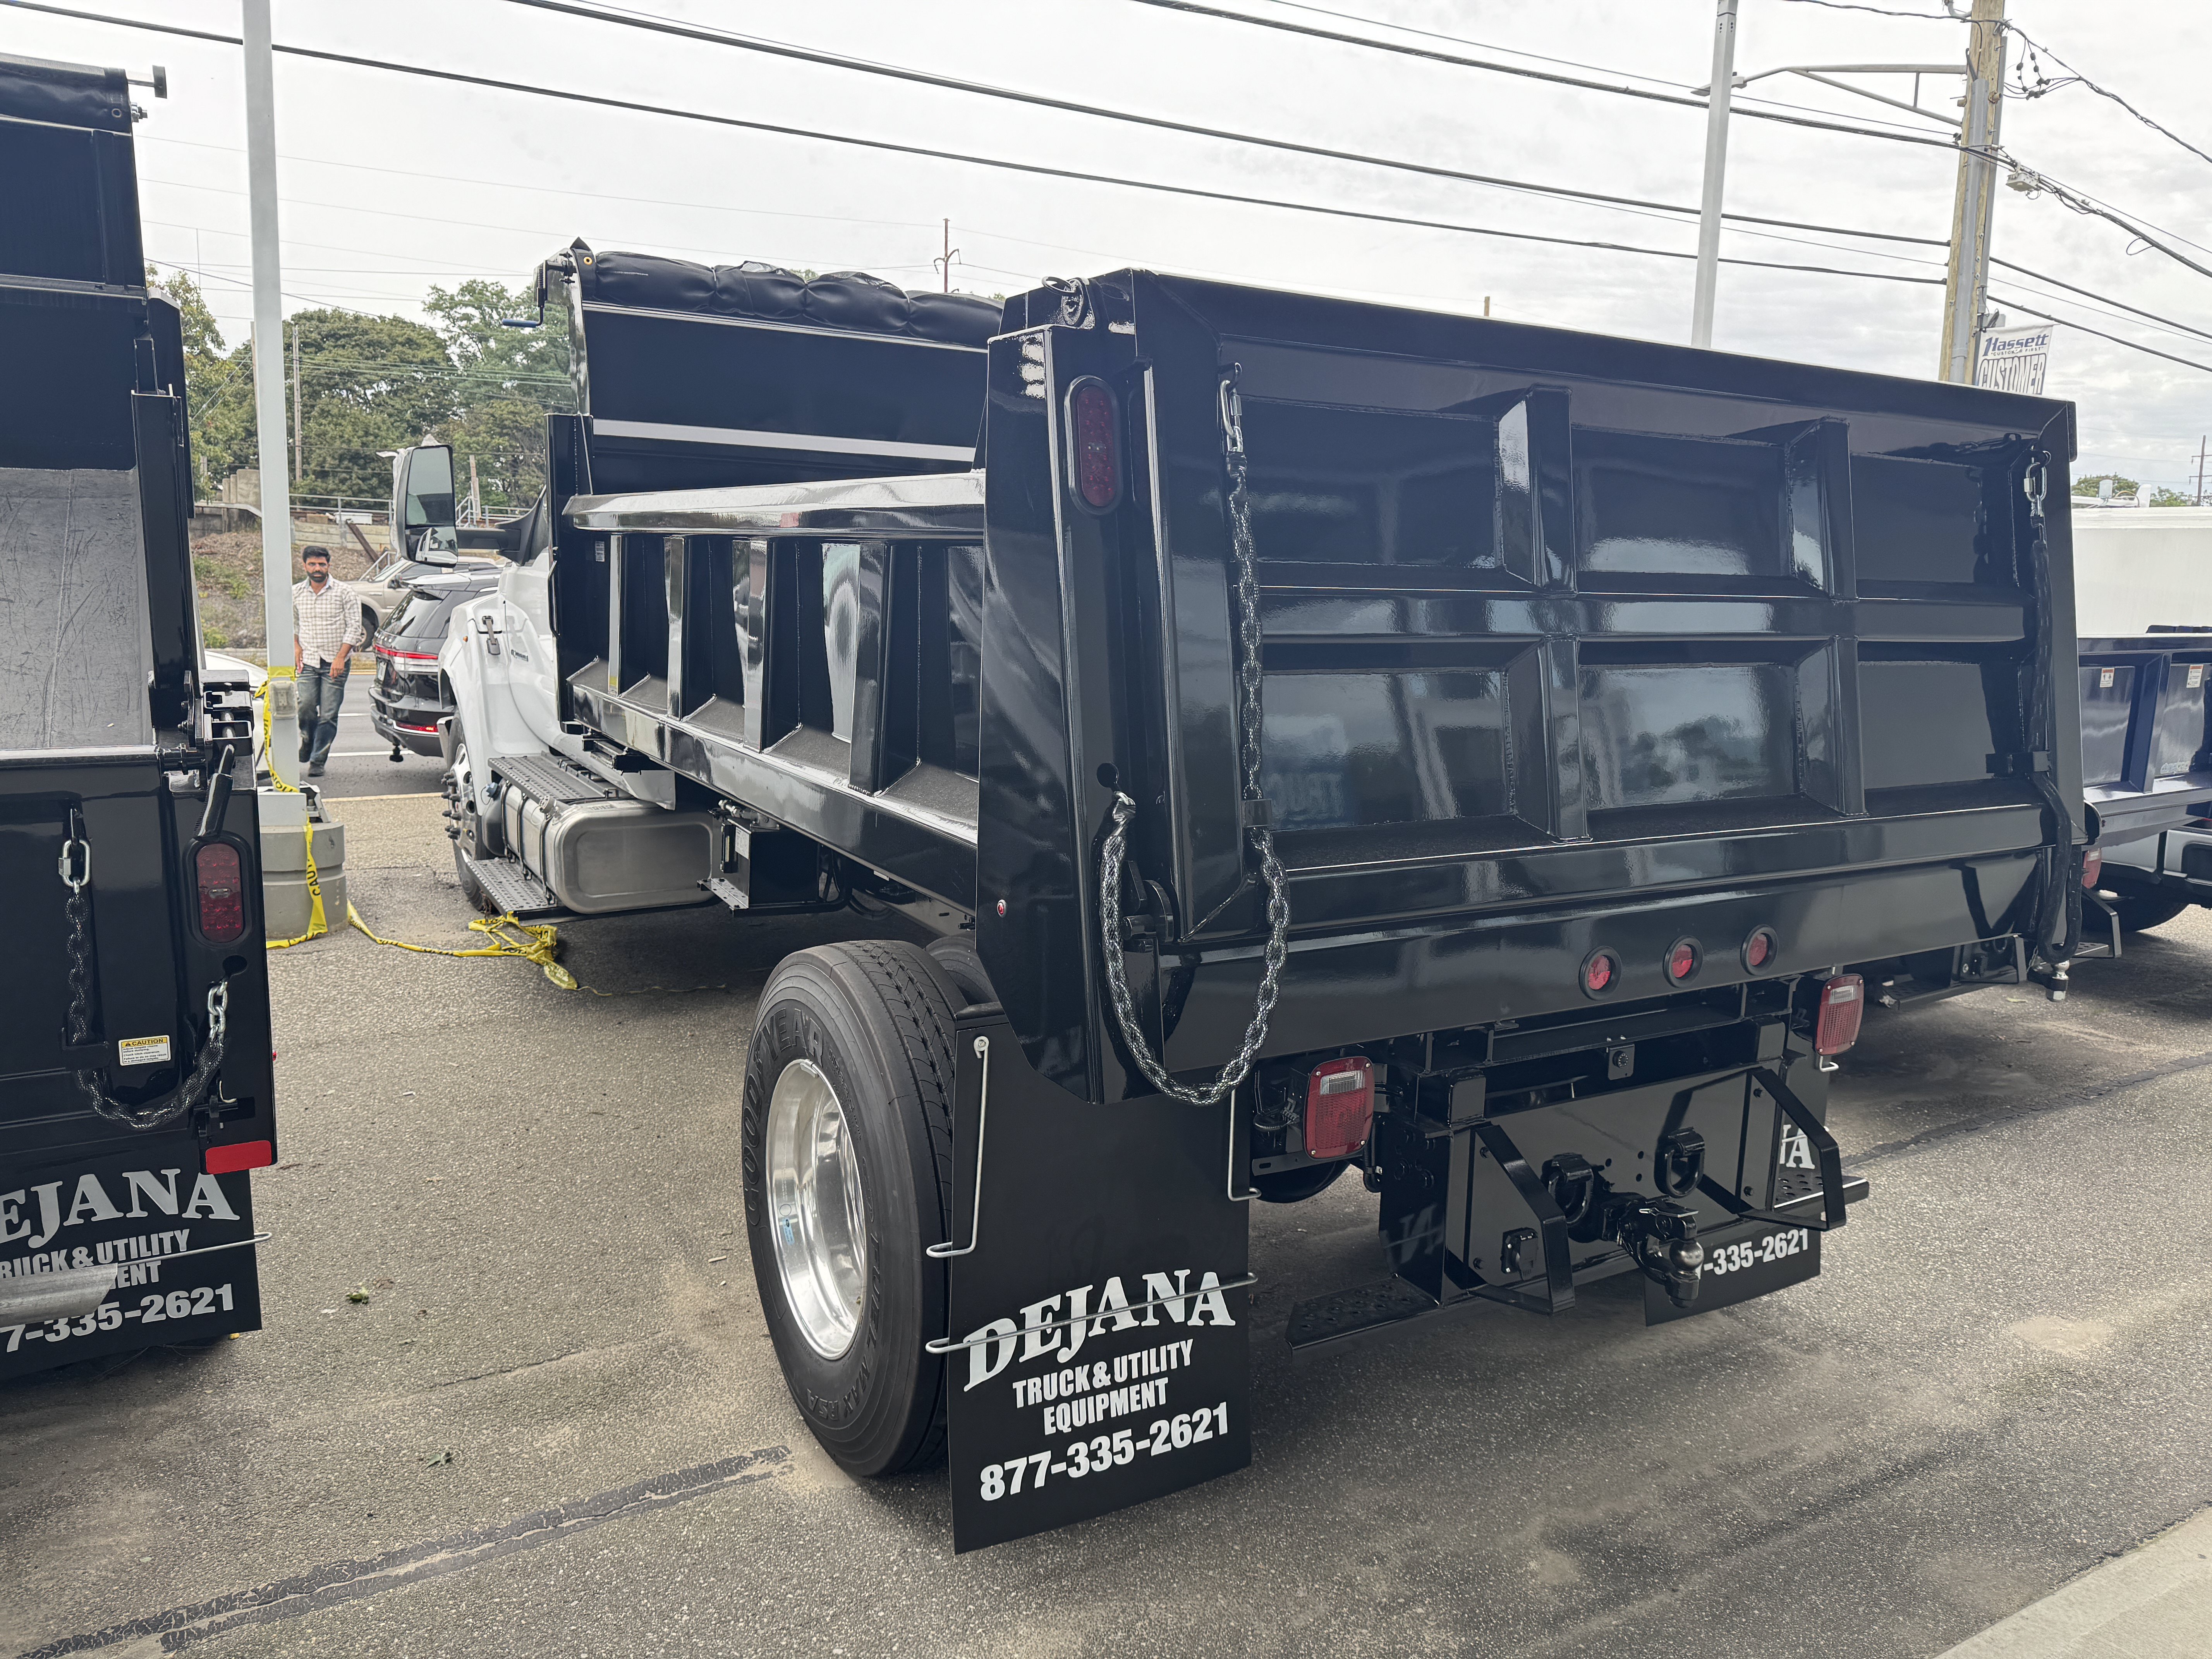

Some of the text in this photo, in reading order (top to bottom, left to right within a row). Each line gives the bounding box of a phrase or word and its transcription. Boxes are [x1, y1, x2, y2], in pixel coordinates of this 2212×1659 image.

[1978, 353, 2046, 395] CUSTOMER
[1982, 334, 2049, 356] Hassett
[72, 1246, 94, 1268] &
[96, 1229, 190, 1264] UTILITY
[963, 1269, 1236, 1392] DEJANA
[1012, 1339, 1194, 1409] TRUCK & UTILITY
[1043, 1377, 1169, 1436] EQUIPMENT
[980, 1401, 1228, 1501] 877-335-2621
